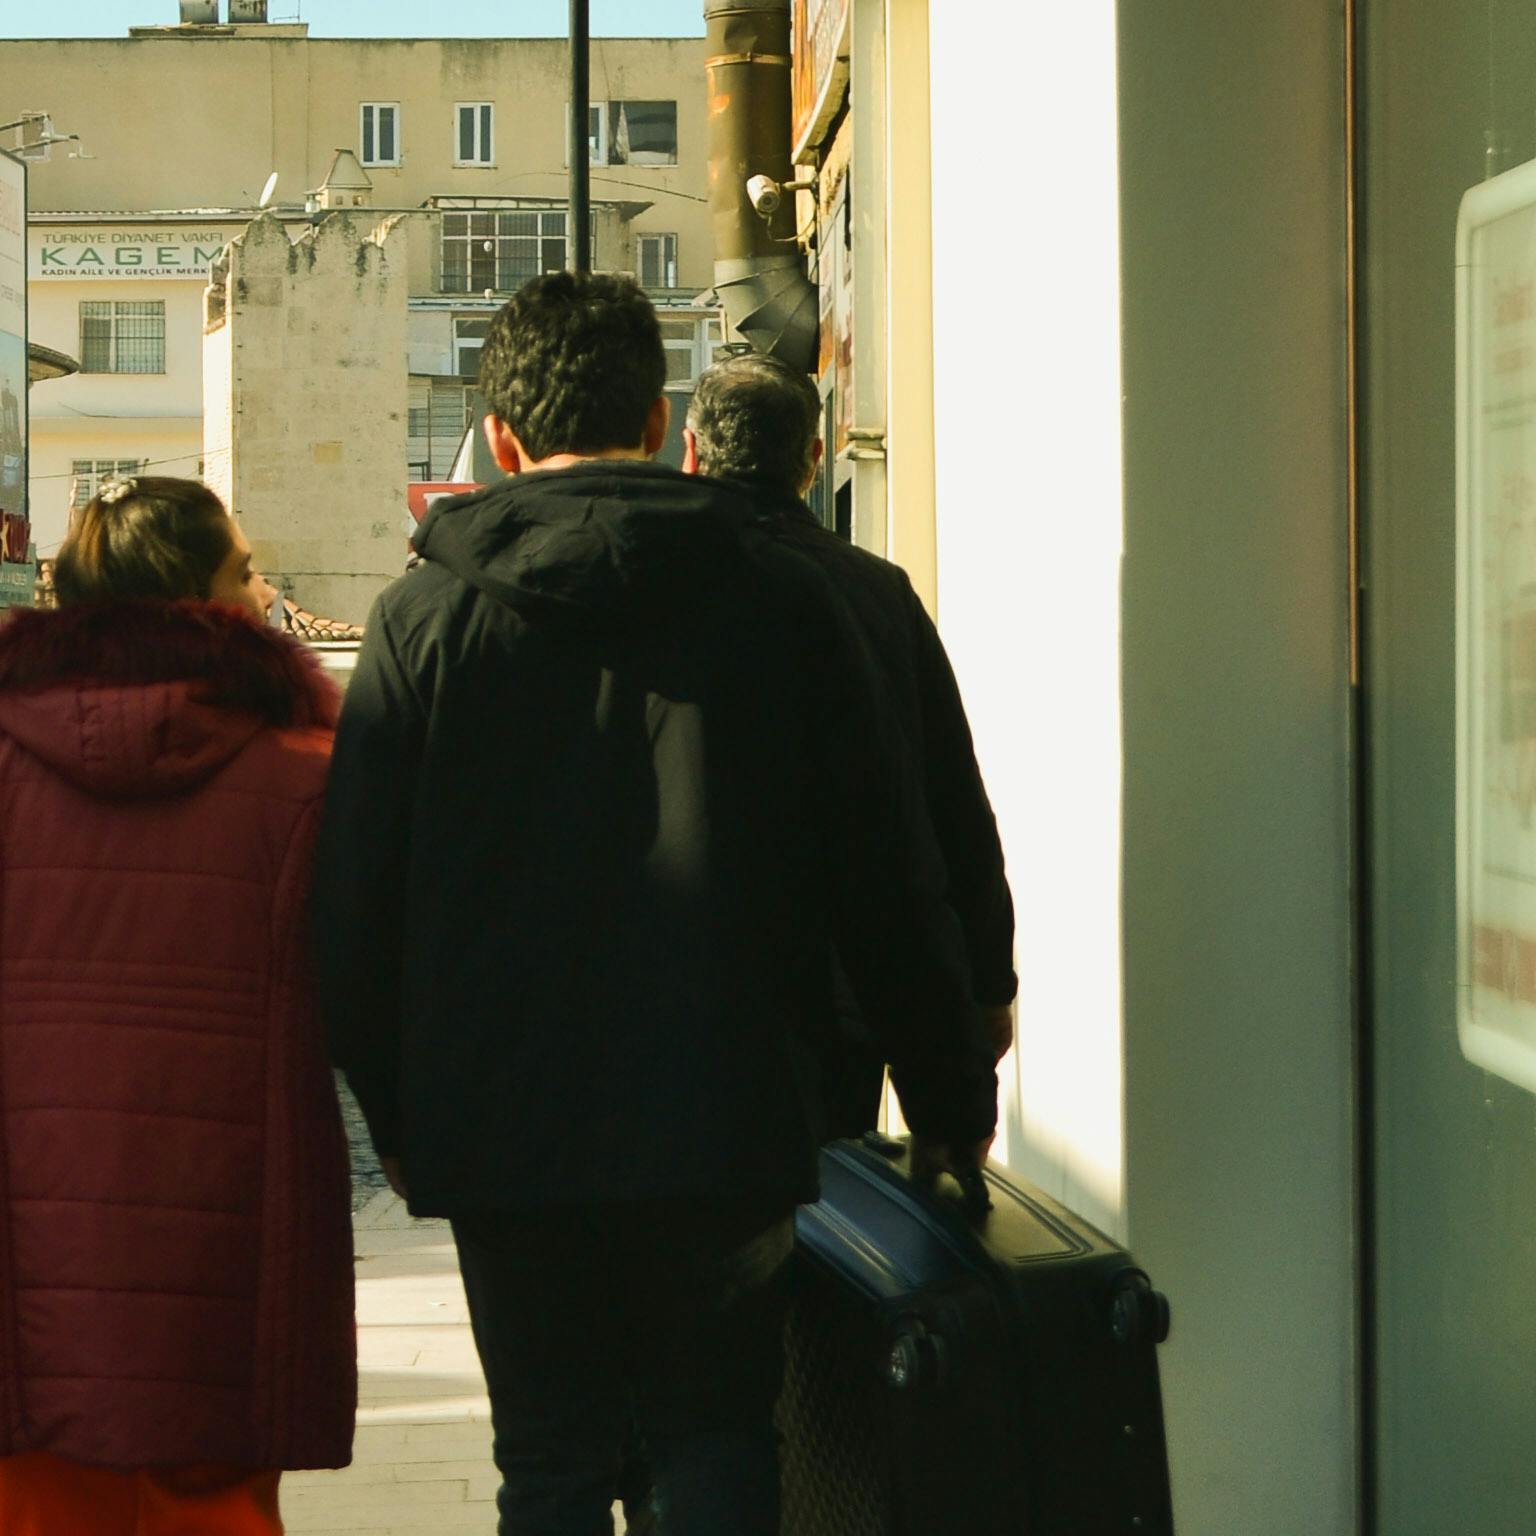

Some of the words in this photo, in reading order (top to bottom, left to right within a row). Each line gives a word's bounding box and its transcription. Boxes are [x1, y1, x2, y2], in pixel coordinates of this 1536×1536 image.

[43, 232, 106, 244] TÜRKİYE
[111, 231, 173, 244] DİYANET
[181, 231, 224, 243] VAKFI
[41, 267, 76, 276] KADIN
[79, 267, 104, 276] AİLE
[107, 267, 122, 275] VE
